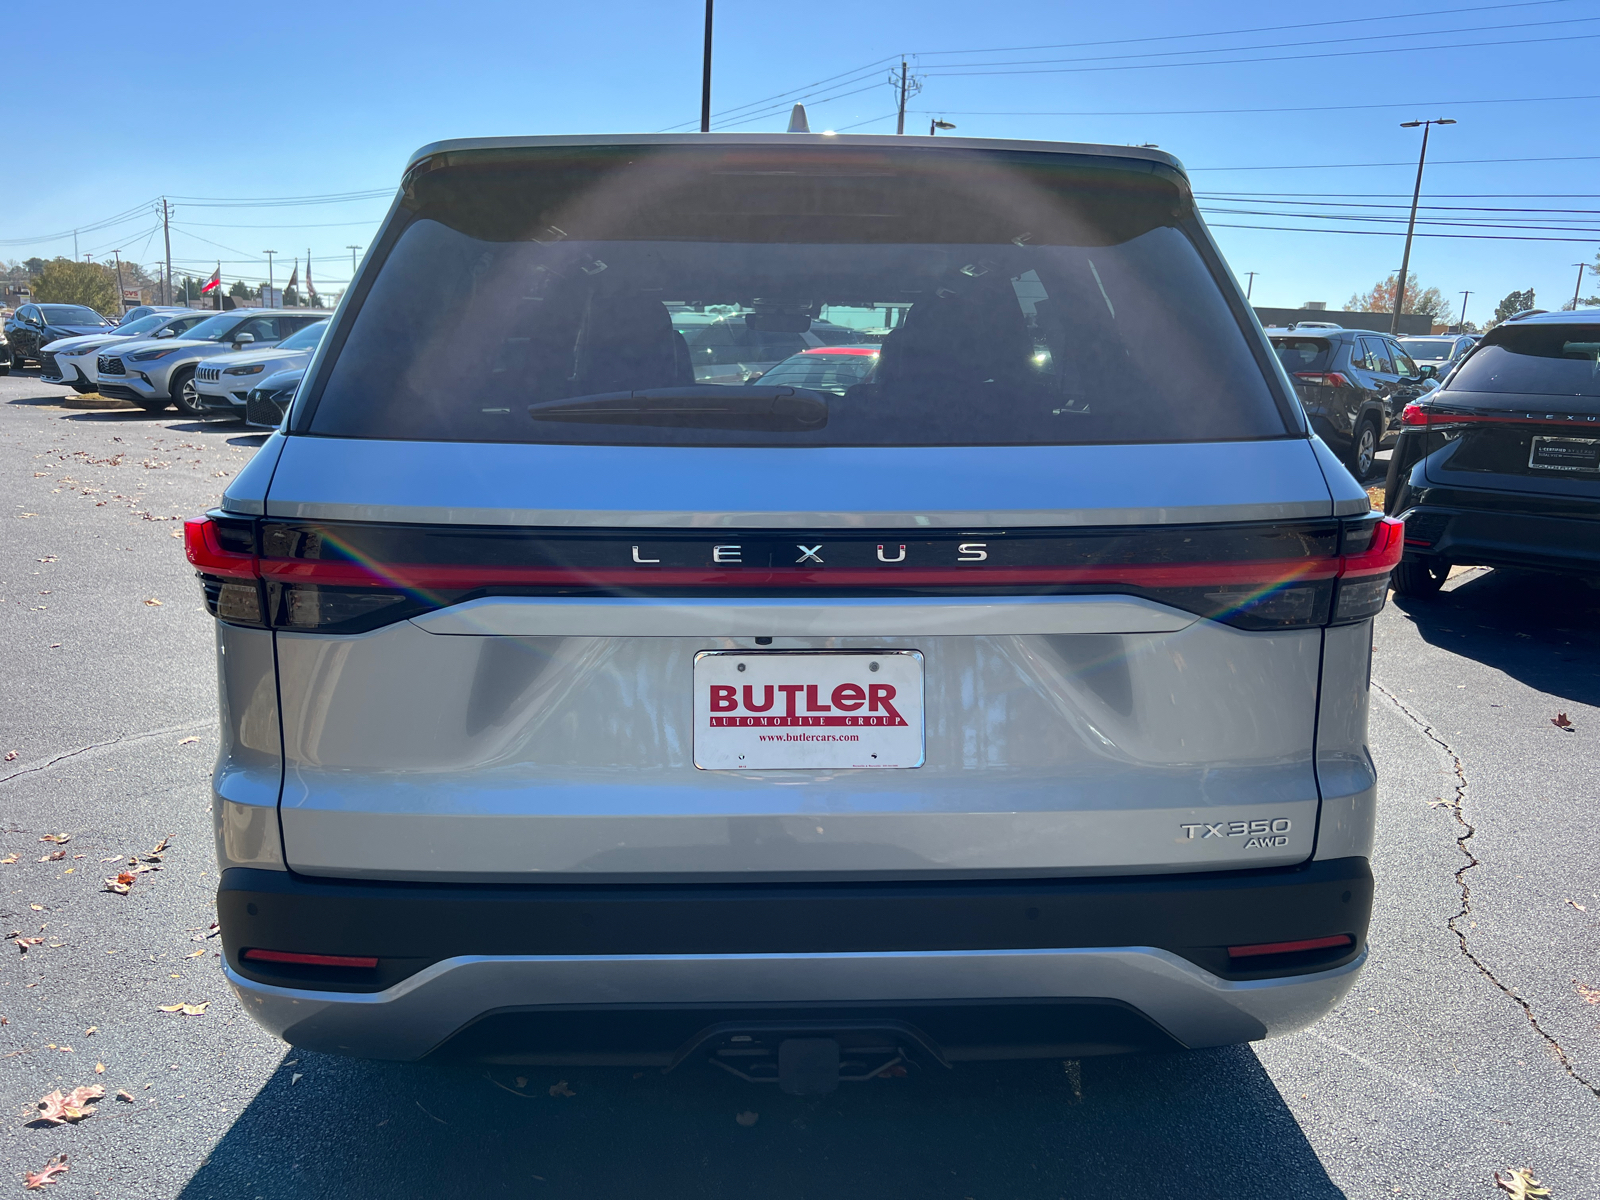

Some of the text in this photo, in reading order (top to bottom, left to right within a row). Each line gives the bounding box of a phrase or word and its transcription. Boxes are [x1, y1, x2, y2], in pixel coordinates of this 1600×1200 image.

[632, 543, 988, 563] LEXUS
[711, 717, 901, 726] AUTOMOTIVE GROUP
[759, 733, 859, 742] www.butlercars.com
[1243, 835, 1289, 849] AWD
